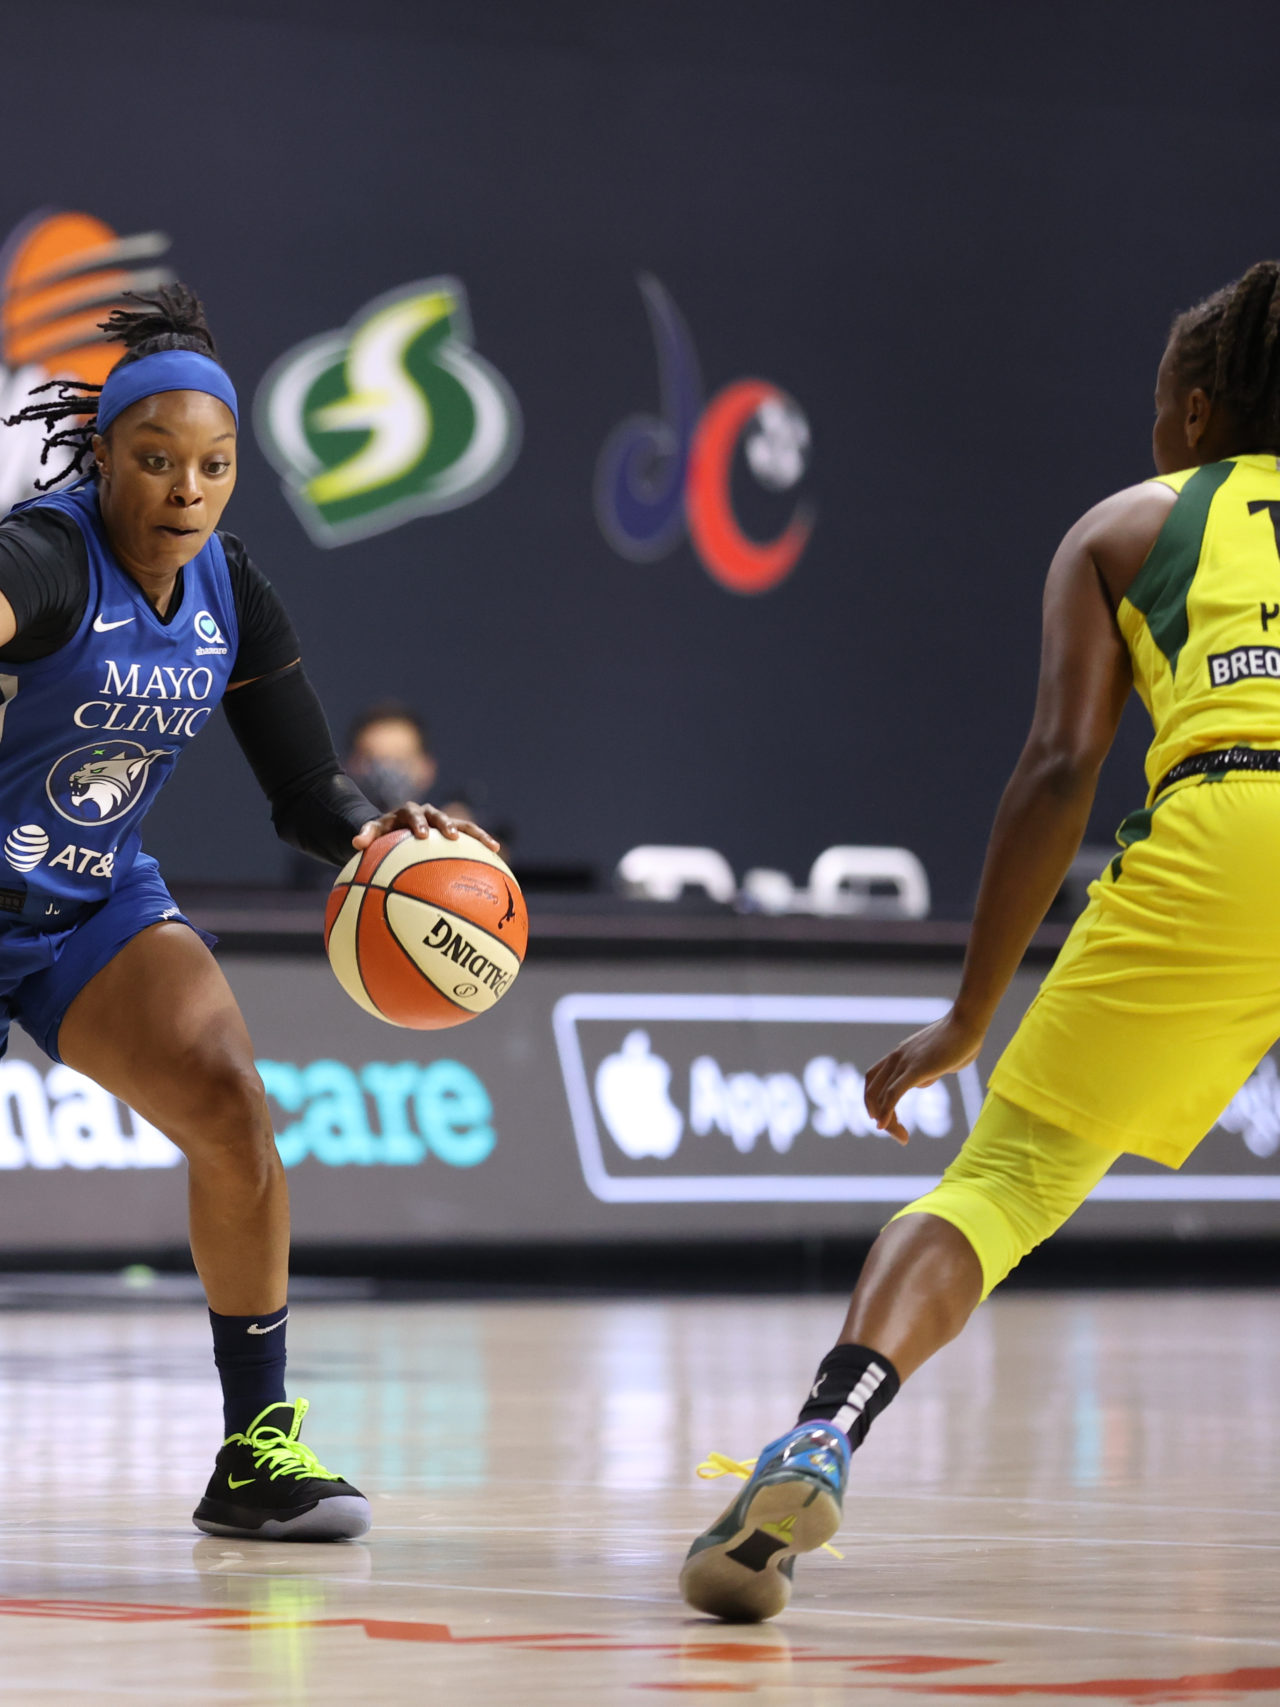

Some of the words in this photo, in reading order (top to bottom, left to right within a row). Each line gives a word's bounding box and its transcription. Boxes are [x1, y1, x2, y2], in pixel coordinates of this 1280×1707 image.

[99, 660, 213, 701] MAYO
[73, 701, 211, 738] CLINIC
[48, 844, 118, 878] AT&
